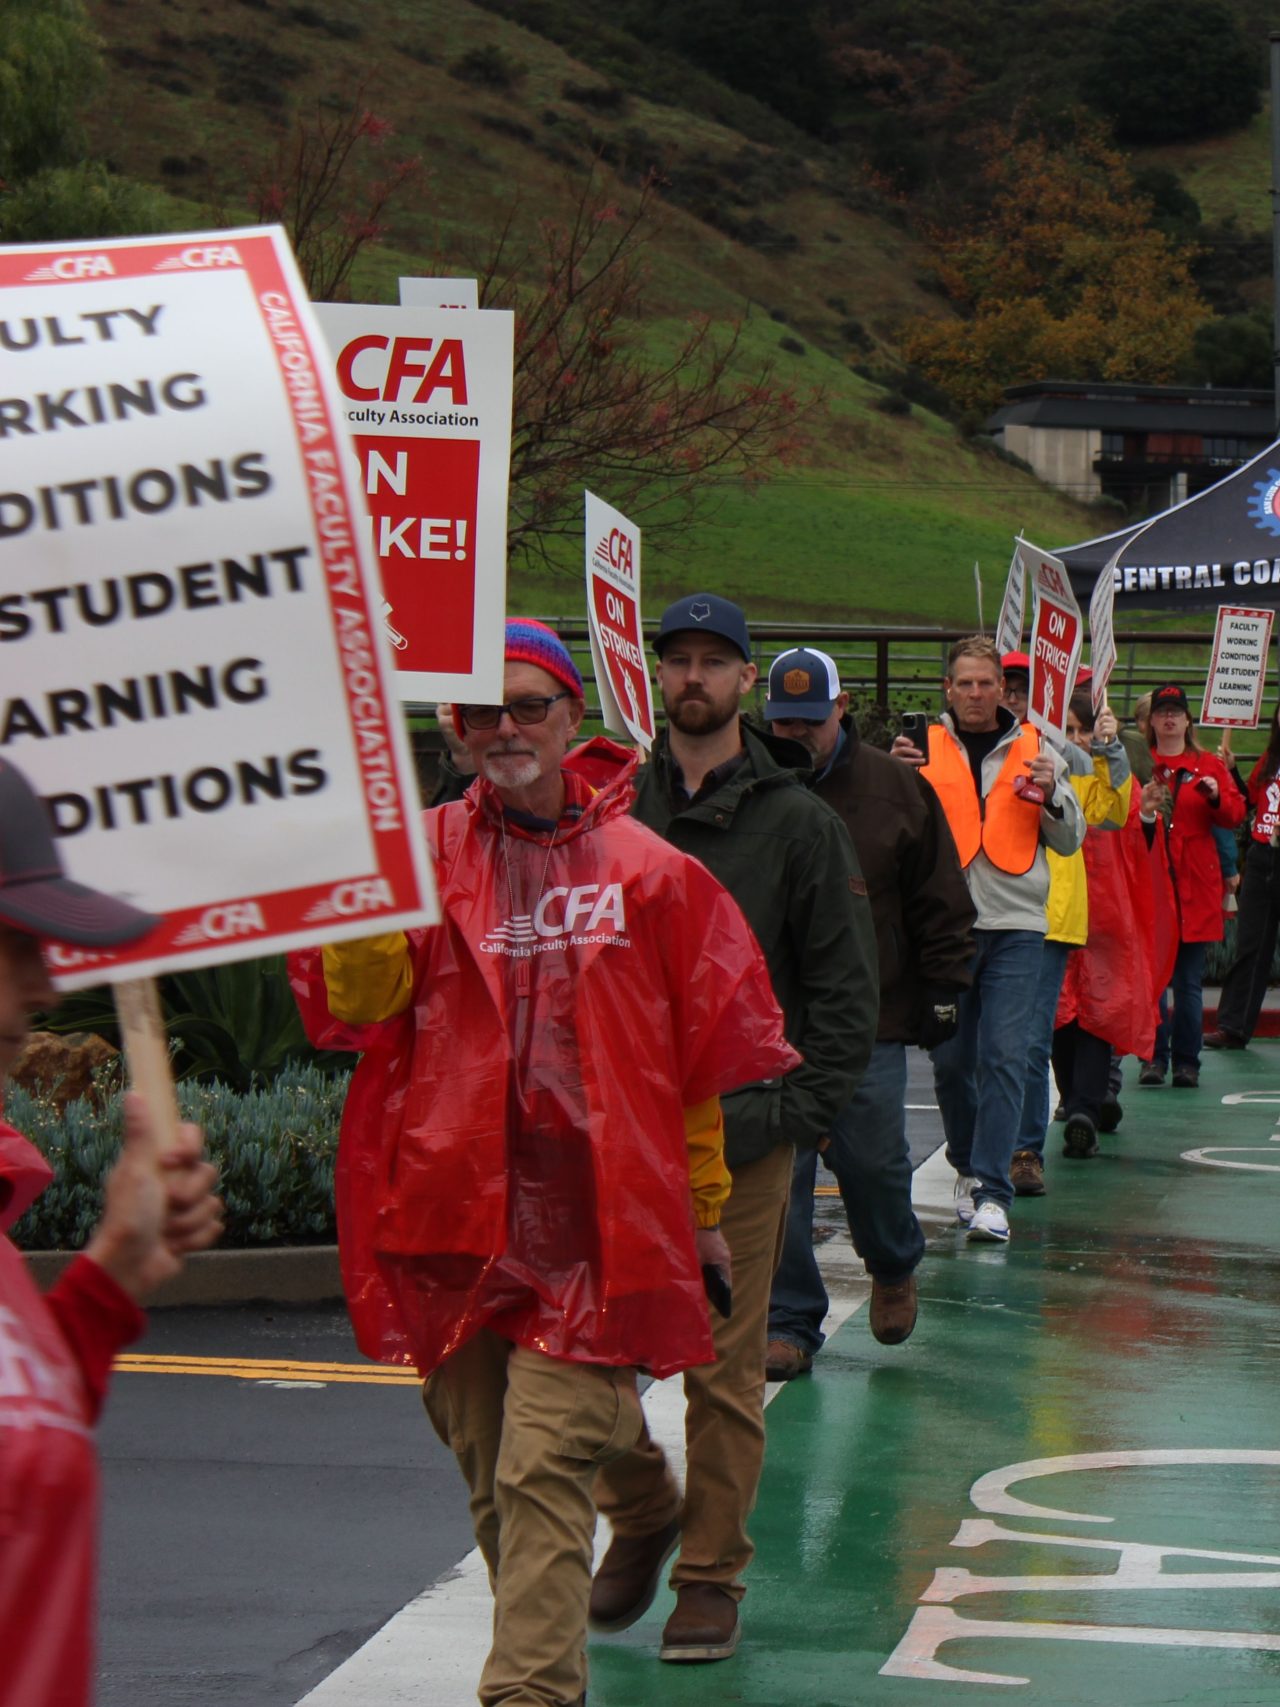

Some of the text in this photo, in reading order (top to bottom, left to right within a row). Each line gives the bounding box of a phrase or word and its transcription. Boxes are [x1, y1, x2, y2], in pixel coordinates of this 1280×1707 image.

[51, 255, 116, 280] CFA
[181, 245, 243, 269] CFA
[0, 303, 165, 352] ULTY
[336, 334, 468, 406] CFA
[0, 372, 208, 439] RKING
[345, 408, 479, 427] culty Association
[352, 449, 408, 496] N
[0, 451, 273, 540] DITIONS
[259, 289, 402, 833] CALIFORNIA FACULTY ASSOCIATION
[608, 527, 634, 580] CFA
[0, 545, 309, 642] STUDENT
[1113, 563, 1225, 594] CENTRAL
[606, 592, 625, 628] ON
[1048, 611, 1066, 640] ON
[1230, 622, 1259, 632] FACULTY
[600, 622, 642, 671] STRIKE!
[1036, 636, 1070, 675] STRIKE!
[1220, 651, 1260, 663] CONDITIONS
[1226, 637, 1258, 647] WORKING
[1216, 666, 1260, 677] ARE STUDENT
[1219, 682, 1253, 693] LEARNING
[2, 656, 269, 746] ARNING
[1212, 696, 1254, 707] CONDITIONS
[39, 748, 329, 839] DITIONS
[1262, 812, 1280, 824] ON
[330, 878, 395, 917] CFA
[533, 882, 626, 937] CFA
[479, 932, 631, 958] California Faculty Association
